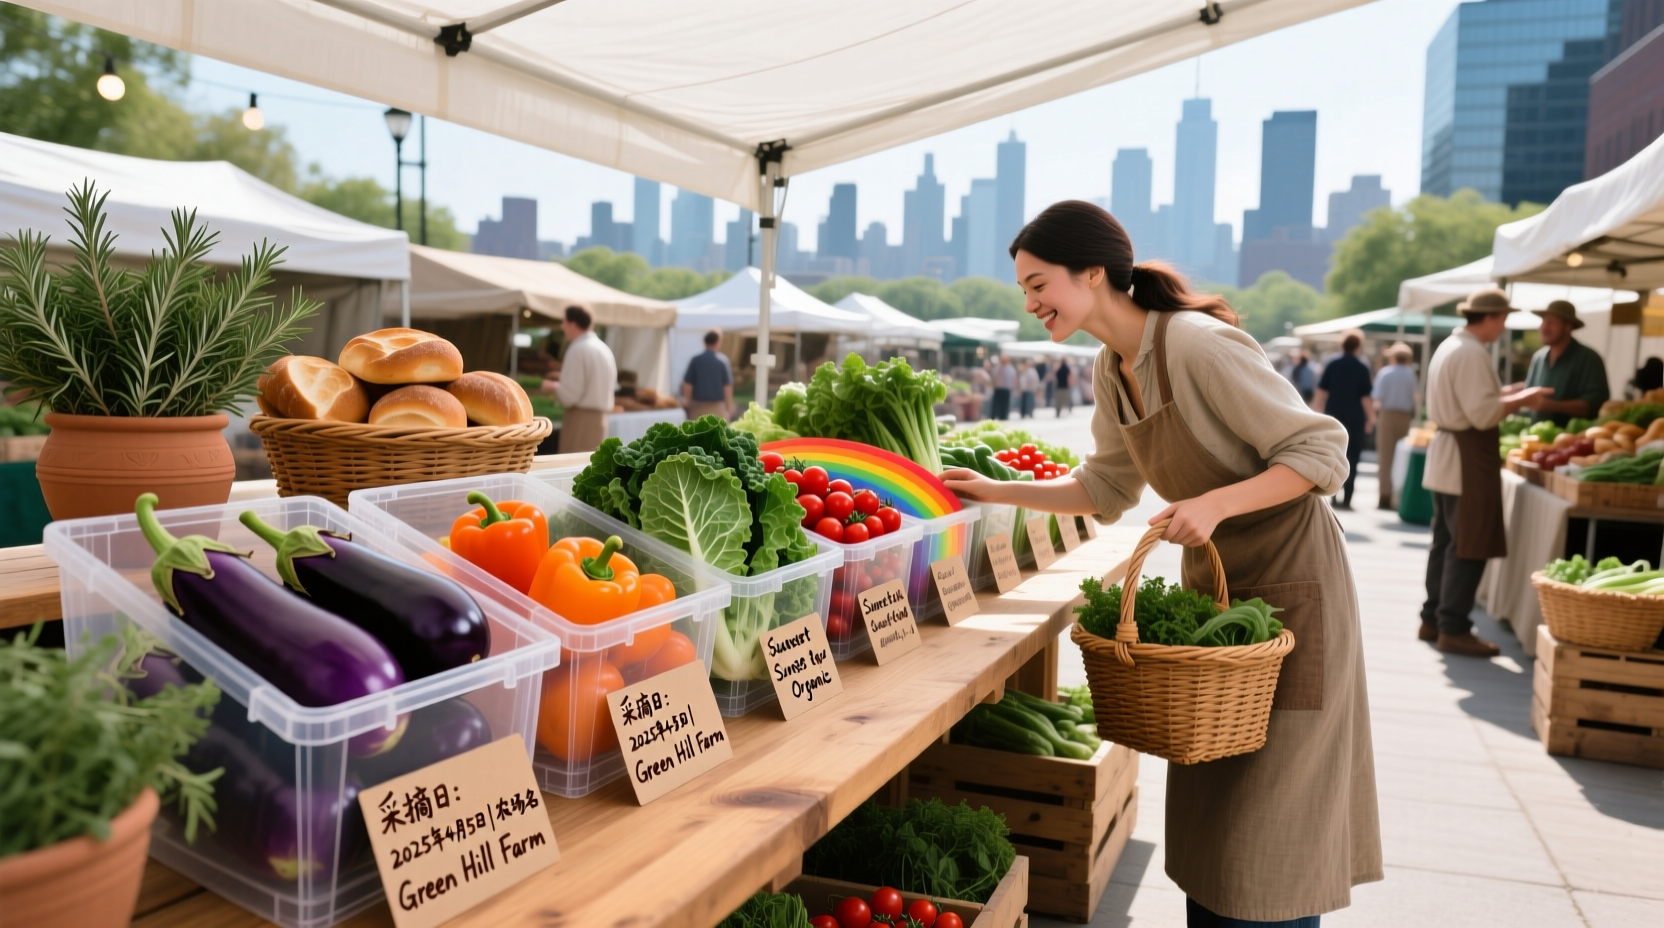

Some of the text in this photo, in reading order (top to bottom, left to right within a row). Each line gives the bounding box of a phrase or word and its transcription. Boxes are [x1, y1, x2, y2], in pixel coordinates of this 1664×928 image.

[635, 756, 675, 784] Green
[695, 730, 725, 754] Farm
[378, 783, 461, 835] 采摘日:
[398, 831, 546, 912] Green Hill Farm
